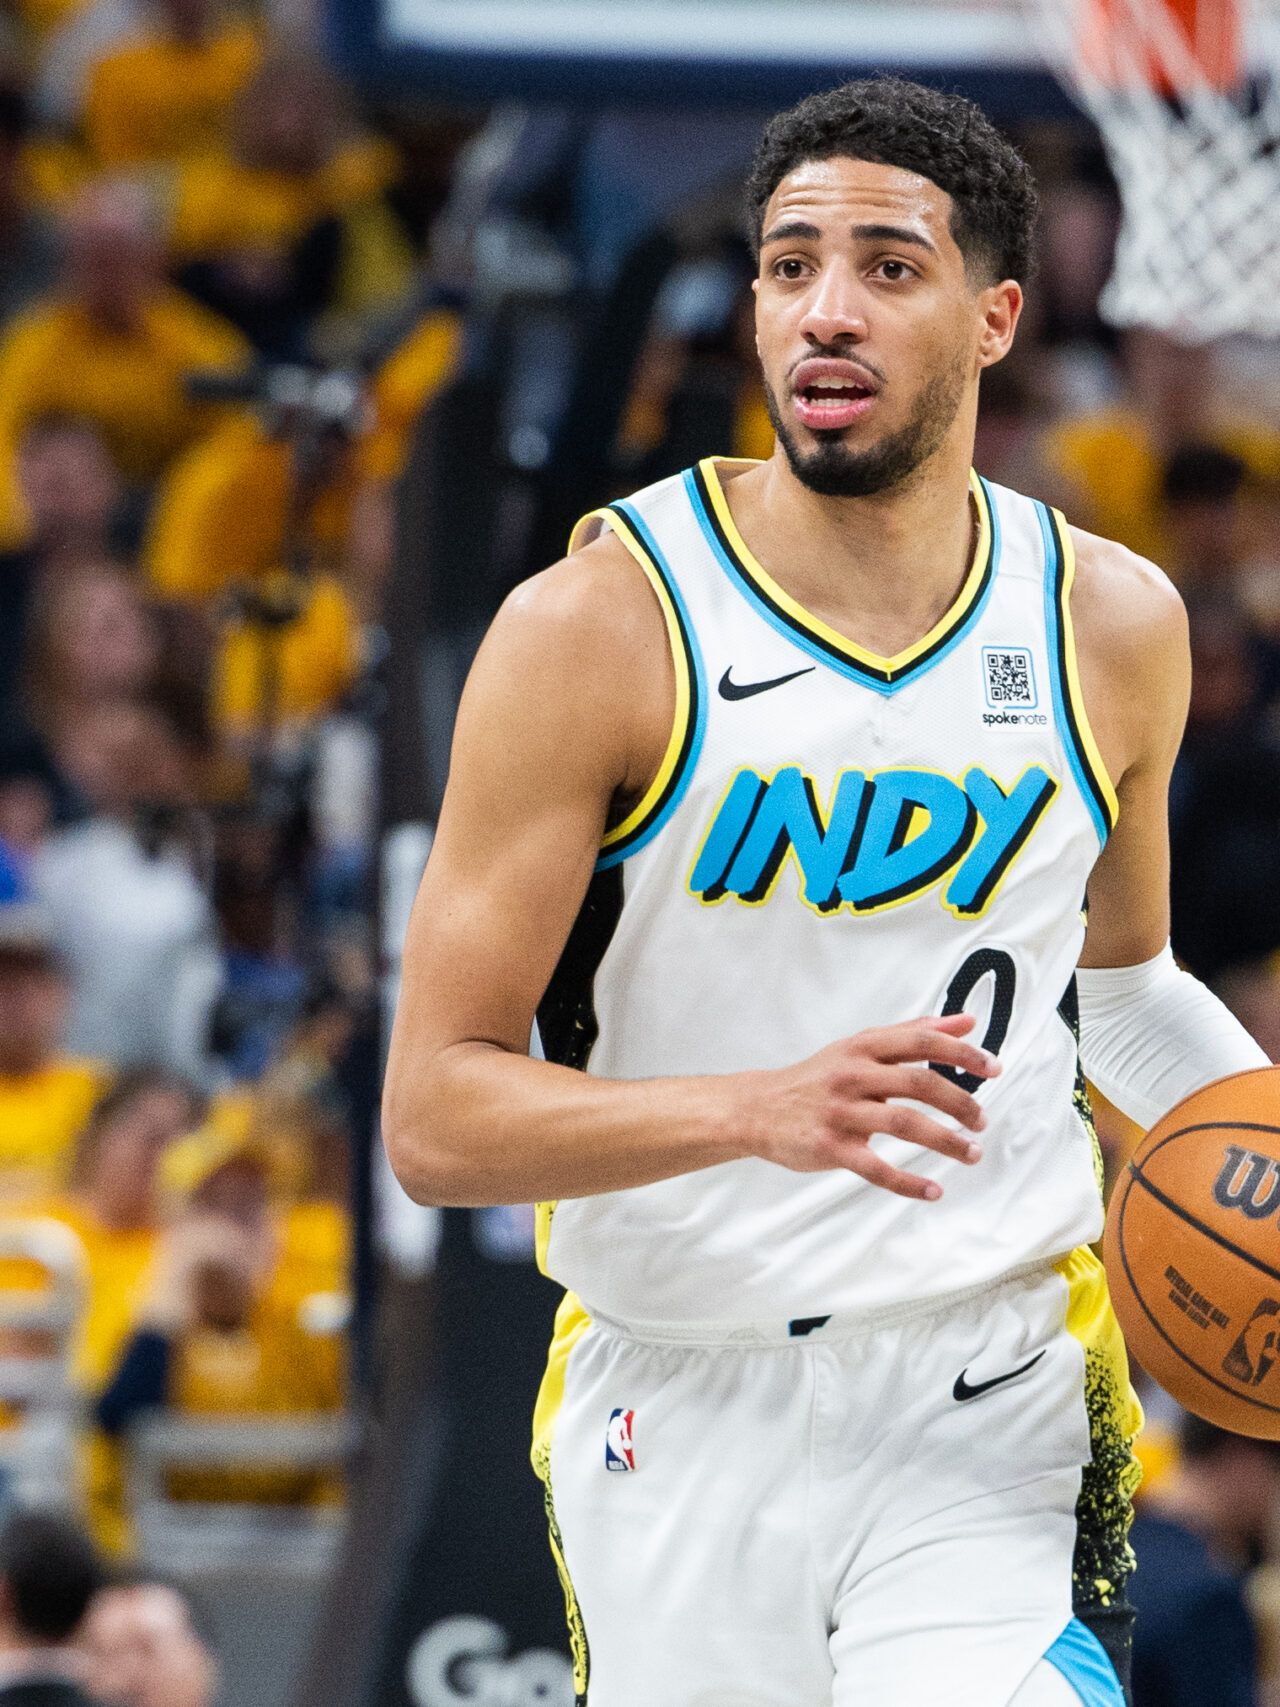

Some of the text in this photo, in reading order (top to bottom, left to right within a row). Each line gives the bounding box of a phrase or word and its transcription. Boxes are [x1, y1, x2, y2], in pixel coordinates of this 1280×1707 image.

[982, 711, 1047, 727] spokenote
[687, 763, 1060, 919] INDY
[927, 948, 1017, 1094] 0
